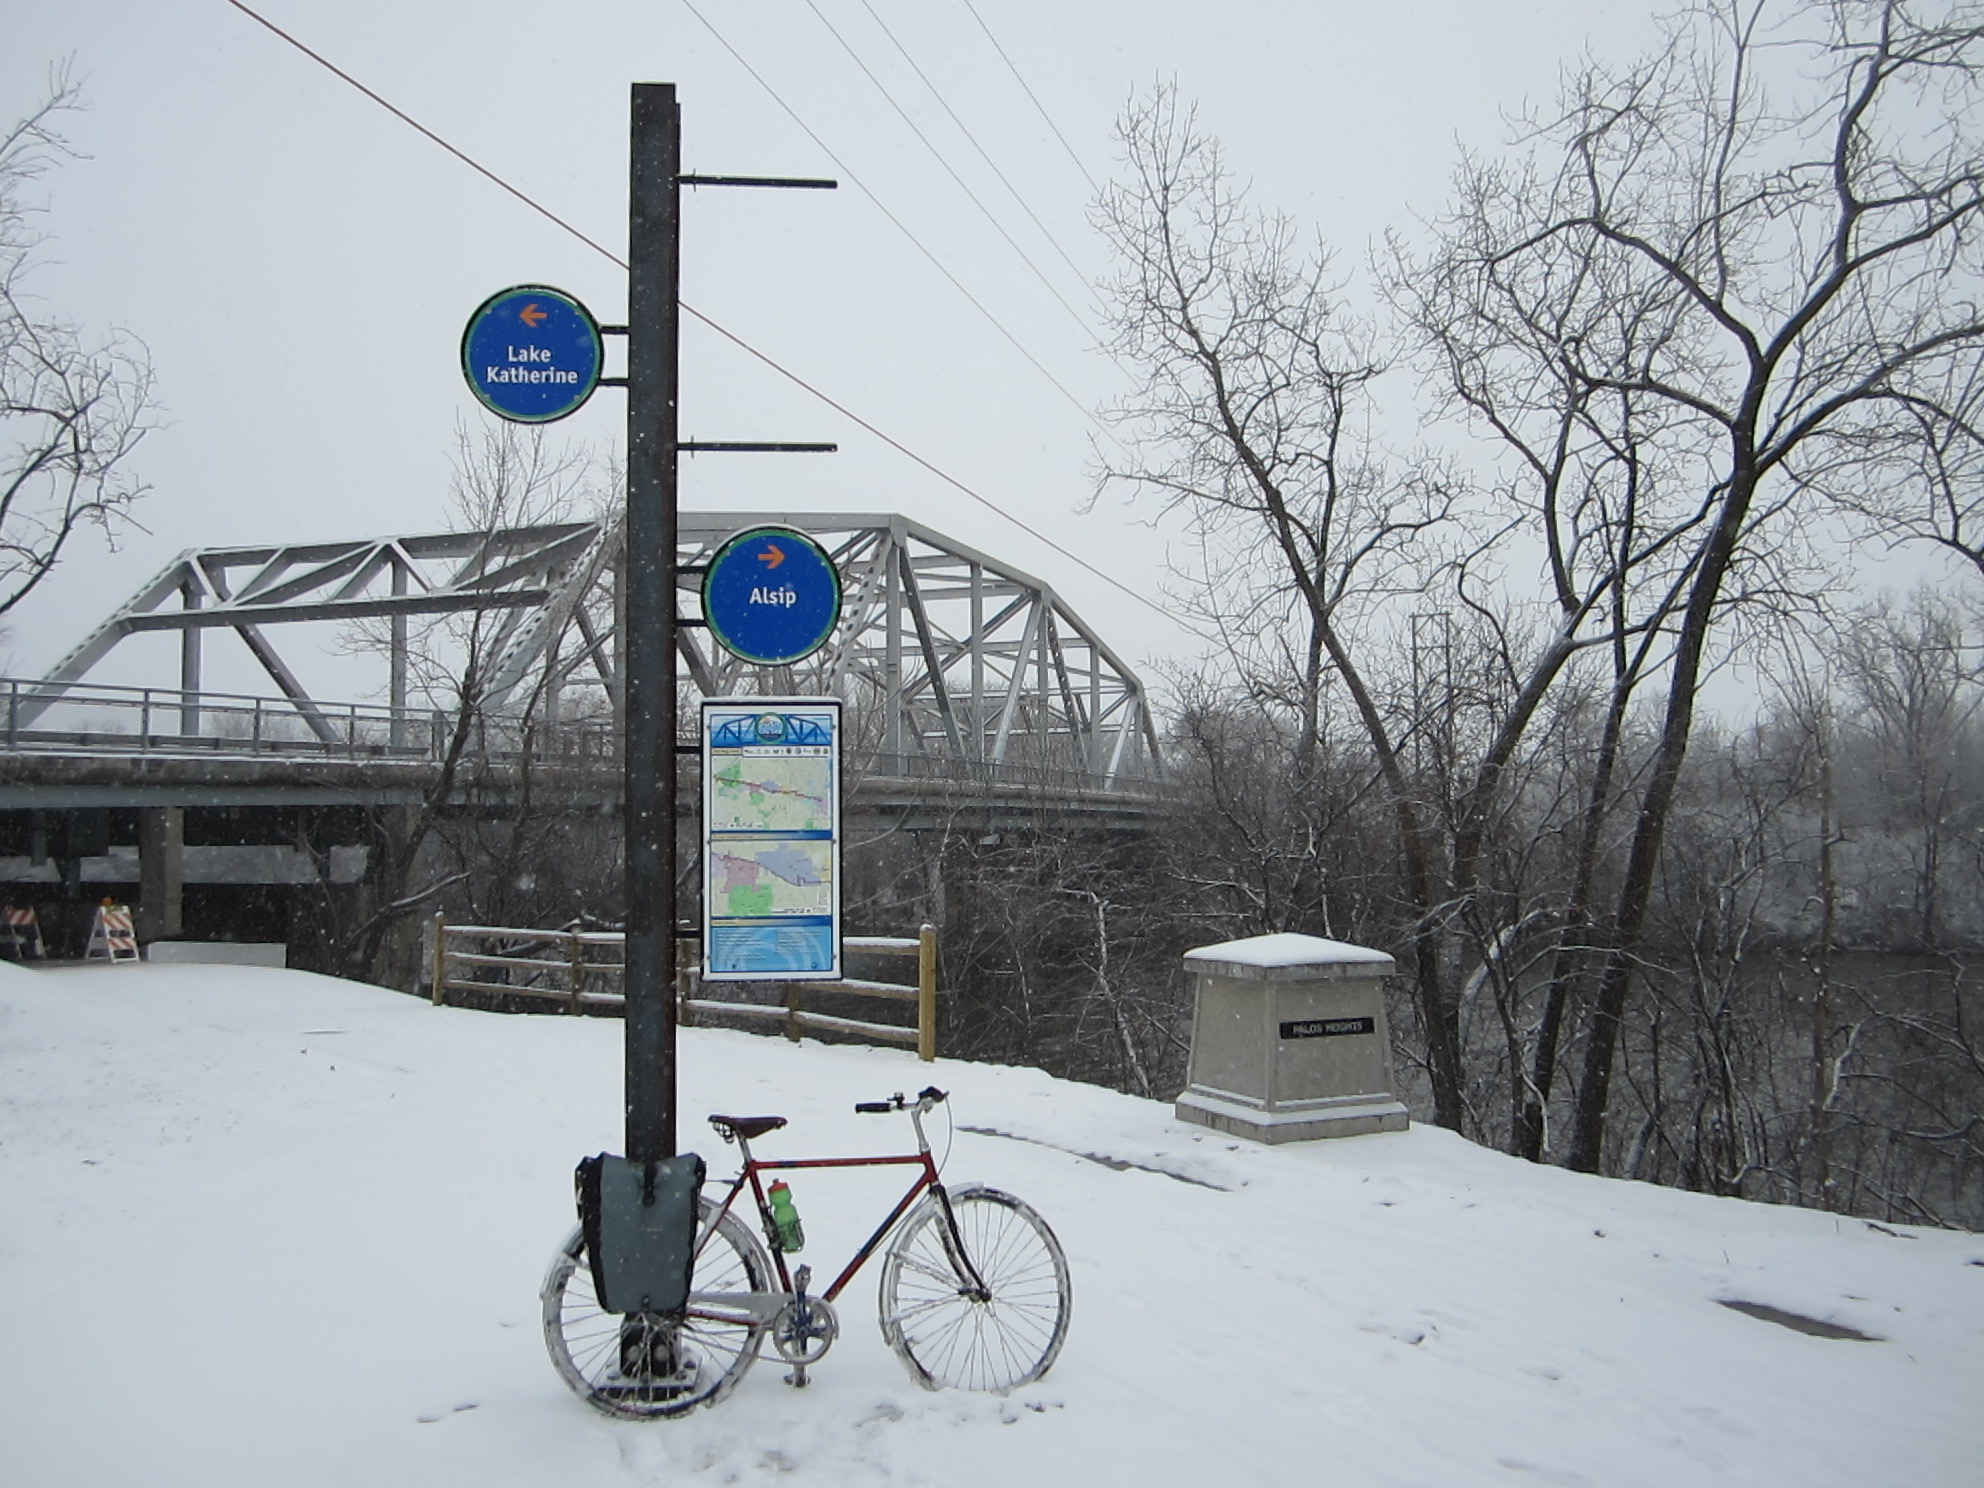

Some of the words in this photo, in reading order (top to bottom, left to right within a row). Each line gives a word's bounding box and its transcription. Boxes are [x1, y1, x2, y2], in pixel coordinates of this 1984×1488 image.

[508, 344, 551, 362] Lake
[487, 366, 578, 384] Katherine
[749, 586, 797, 608] Alsip
